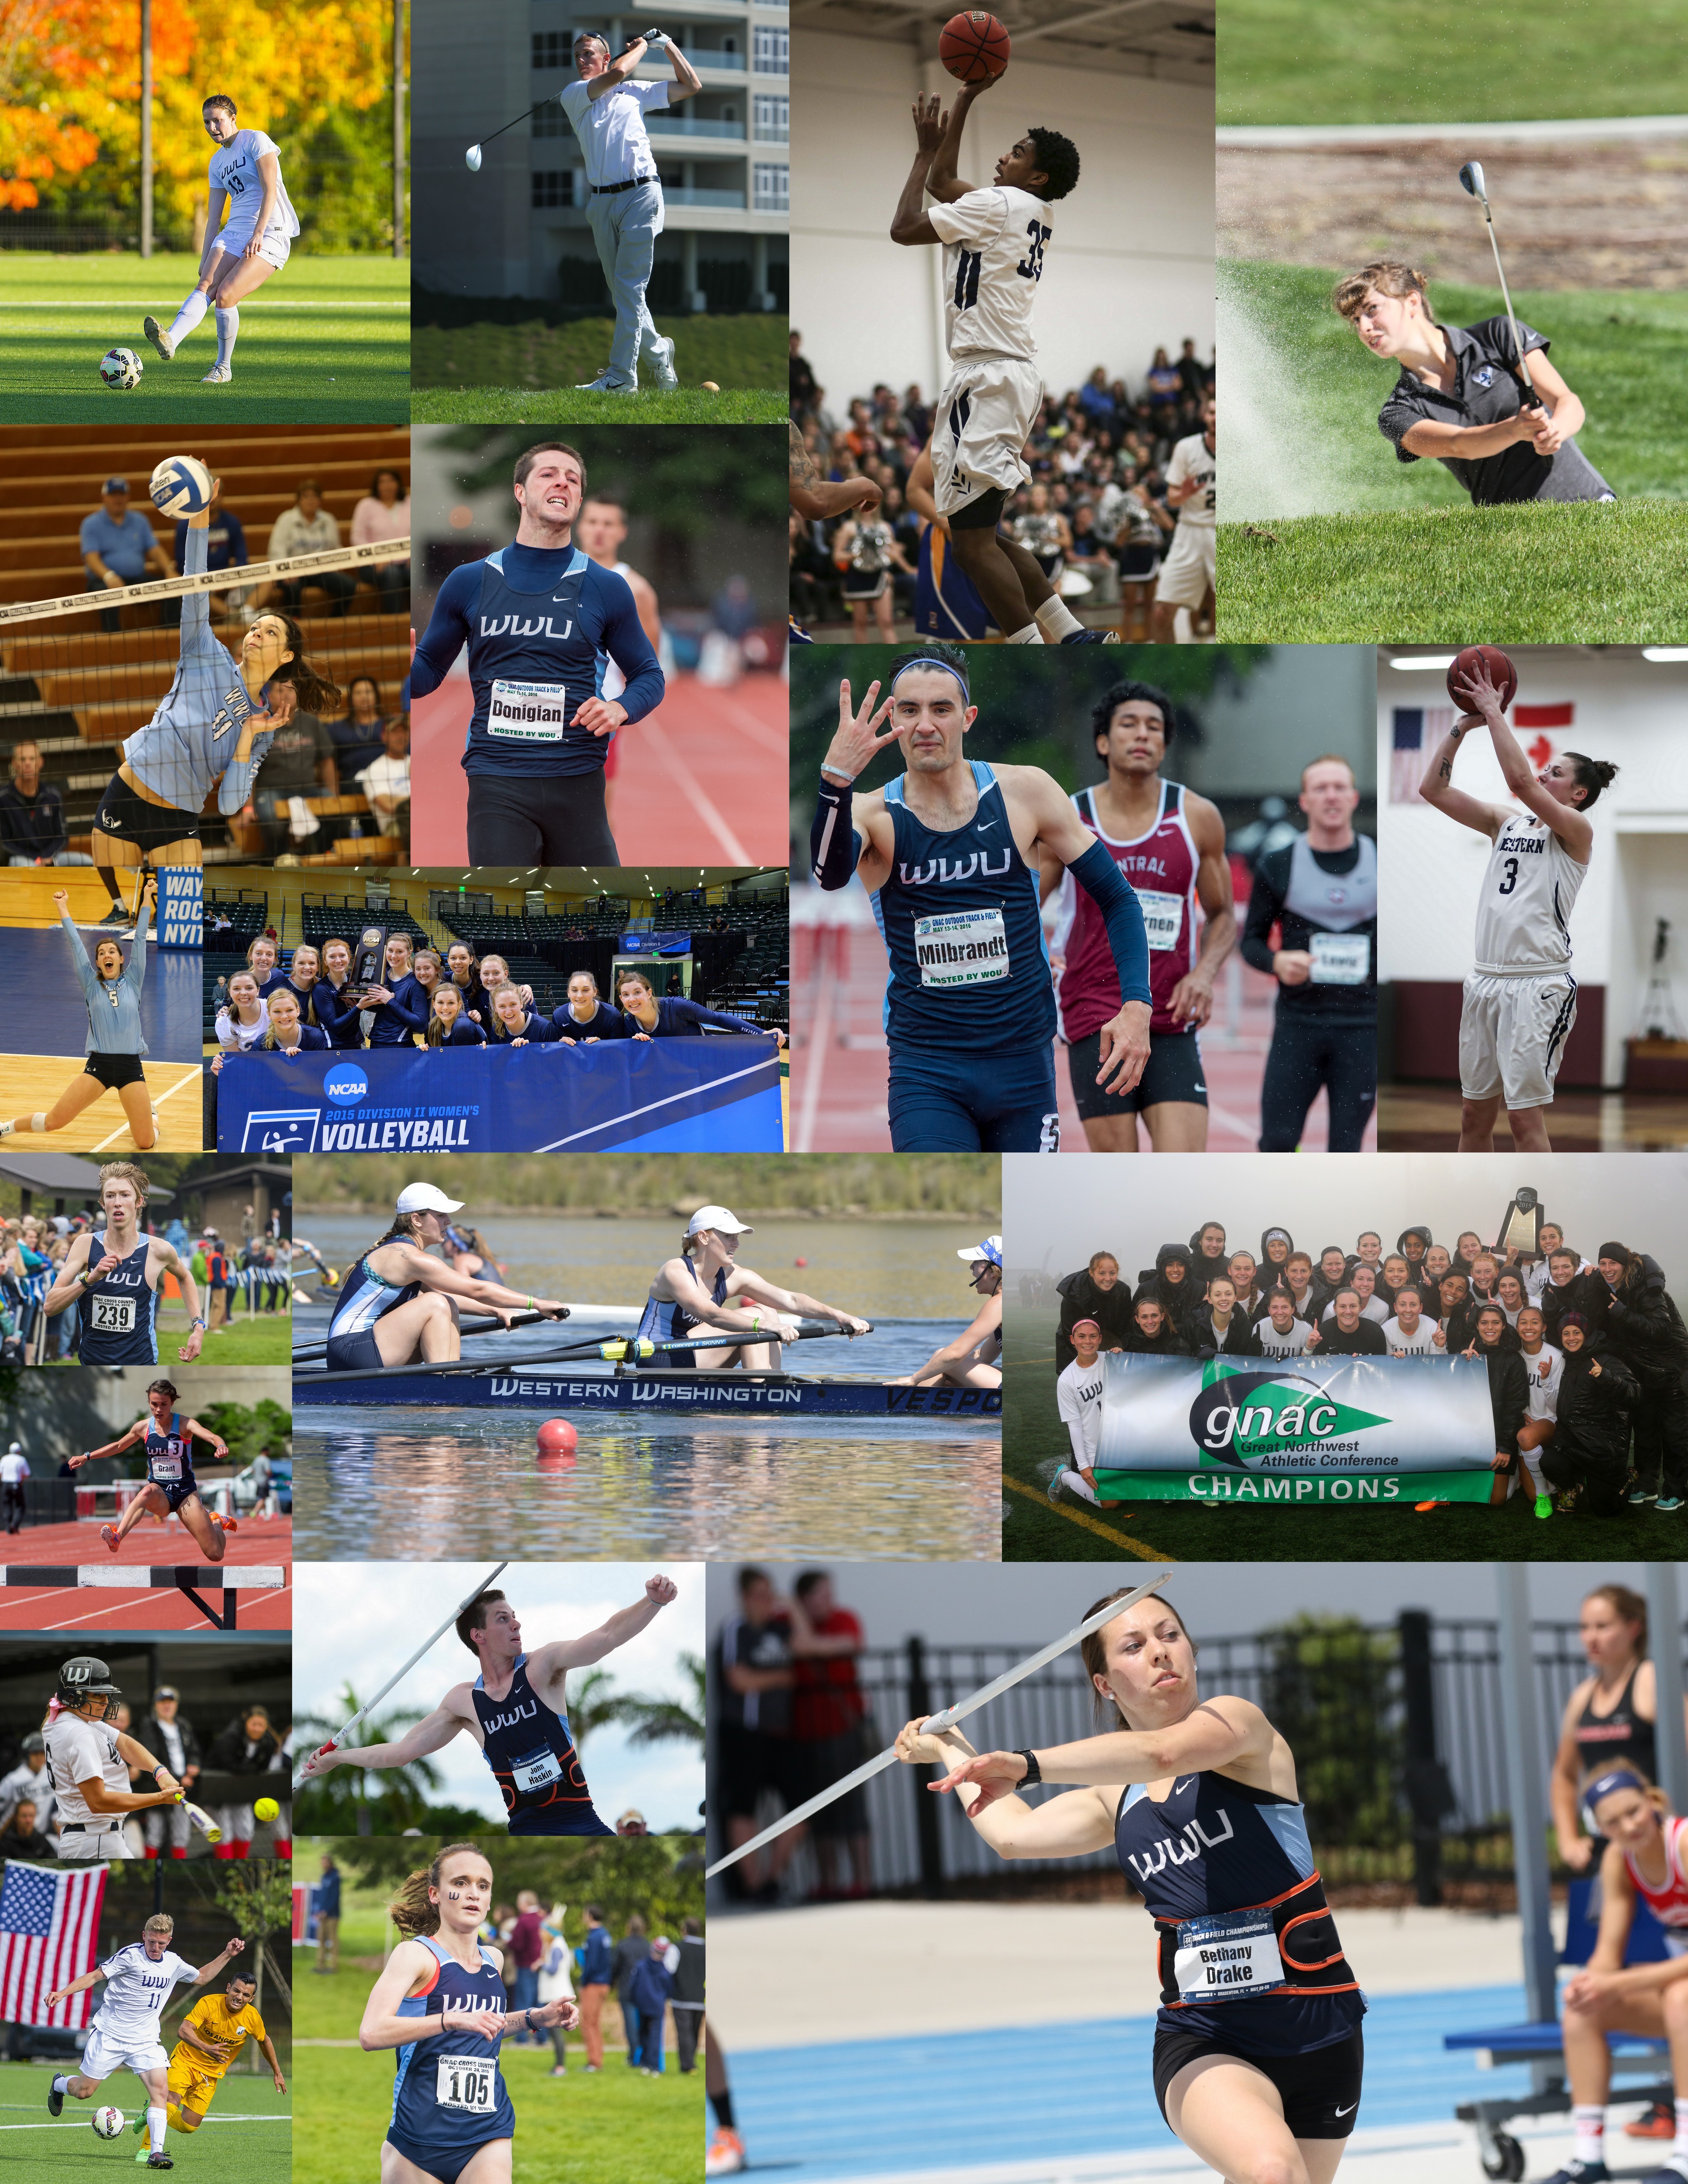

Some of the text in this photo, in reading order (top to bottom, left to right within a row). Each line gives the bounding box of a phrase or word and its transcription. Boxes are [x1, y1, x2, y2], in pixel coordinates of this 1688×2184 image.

[228, 175, 244, 195] 13
[1017, 219, 1052, 282] 35
[481, 615, 572, 639] WWU
[492, 700, 561, 722] Donigian
[494, 727, 523, 736] HOSTED
[1499, 837, 1546, 854] ESTERN
[899, 848, 1011, 884] WWU
[1499, 858, 1519, 895] 3
[932, 918, 944, 926] GNAC
[945, 915, 965, 925] OUTDOOR
[965, 914, 980, 922] TRACK
[985, 912, 997, 920] FIELD
[918, 936, 1006, 965] Milbrandt
[930, 975, 964, 984] HOSTED
[981, 969, 1002, 978] WOU
[108, 990, 119, 1007] 5
[328, 1083, 367, 1095] NCAA
[325, 1105, 479, 1121] 2015 DIVISION II WOMEN'S
[322, 1119, 469, 1151] VOLLEYBALL
[983, 1242, 991, 1252] NK
[991, 1252, 999, 1262] NK
[90, 1268, 142, 1286] WU
[98, 1305, 129, 1326] 239
[491, 1378, 802, 1402] WESTERN WASHINGTON
[887, 1388, 1002, 1412] VESPO
[1204, 1404, 1338, 1449] gnac
[147, 1447, 169, 1455] WW
[172, 1442, 179, 1455] 3
[1240, 1440, 1360, 1453] Great Northwest
[1260, 1454, 1399, 1467] Athletic Conference
[1188, 1475, 1400, 1500] CHAMPIONS
[67, 1667, 90, 1682] W
[484, 1699, 537, 1735] WWU
[46, 1743, 56, 1791] 6
[530, 1763, 545, 1774] John
[528, 1769, 553, 1785] Haskin
[1127, 1809, 1234, 1882] WWU
[1192, 1934, 1205, 1942] TRACK
[1210, 1929, 1225, 1938] FIELD
[1226, 1923, 1268, 1936] CHAMPIONSHIPS
[1200, 1946, 1252, 1963] Bethany
[1206, 1964, 1253, 1984] Drake
[148, 1992, 161, 2009] 11
[203, 2027, 213, 2037] LOS
[440, 2057, 457, 2065] GNAC
[448, 2071, 488, 2106] 105
[442, 2101, 468, 2110] HOSTED
